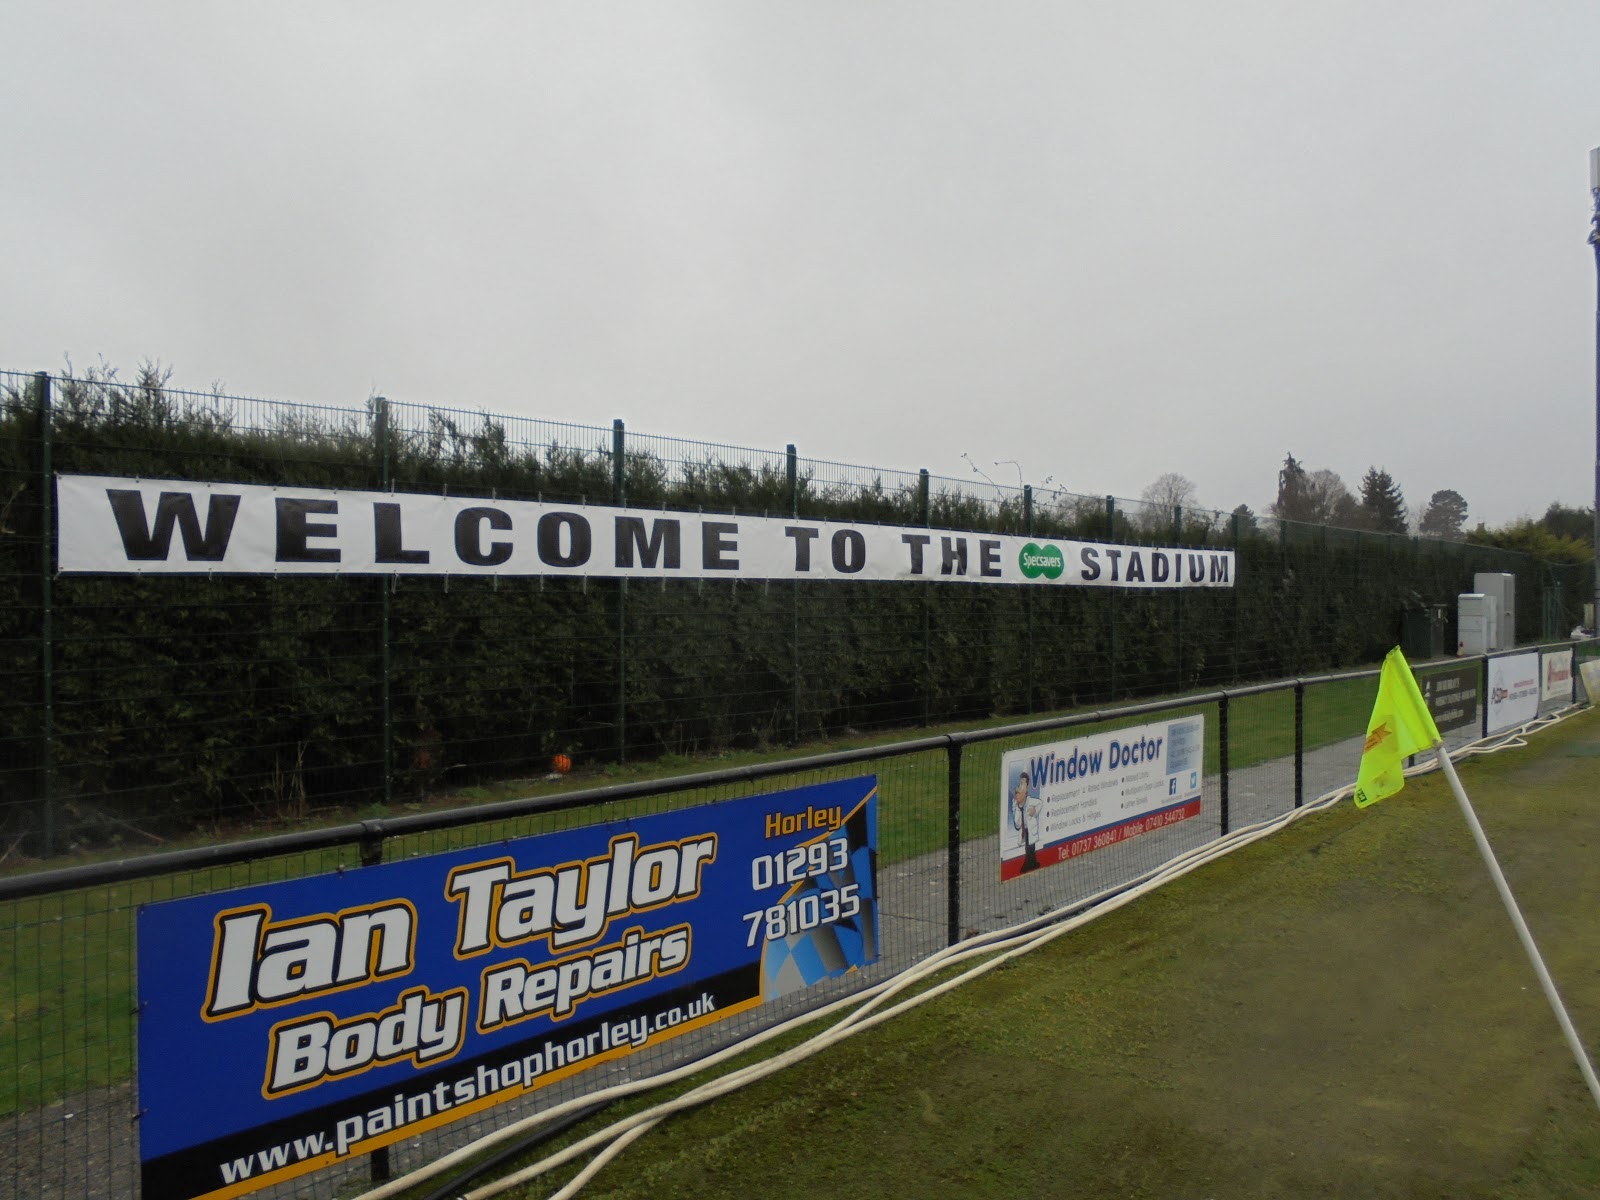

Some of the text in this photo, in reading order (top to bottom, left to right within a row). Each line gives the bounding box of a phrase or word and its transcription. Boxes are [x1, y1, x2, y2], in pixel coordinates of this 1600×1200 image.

[106, 489, 1229, 584] WELCOME TO THE Specsavers STADIUM
[1030, 736, 1162, 788] Window Doctor
[765, 805, 842, 838] Horley
[1071, 837, 1091, 855] 01737
[1093, 829, 1116, 848] 360841
[751, 837, 849, 891] 01293
[208, 835, 715, 1015] Ian Taylor
[742, 885, 860, 948] 781035
[267, 927, 689, 1093] Body Repairs
[218, 993, 715, 1183] www.paintshophorley.co.uk
